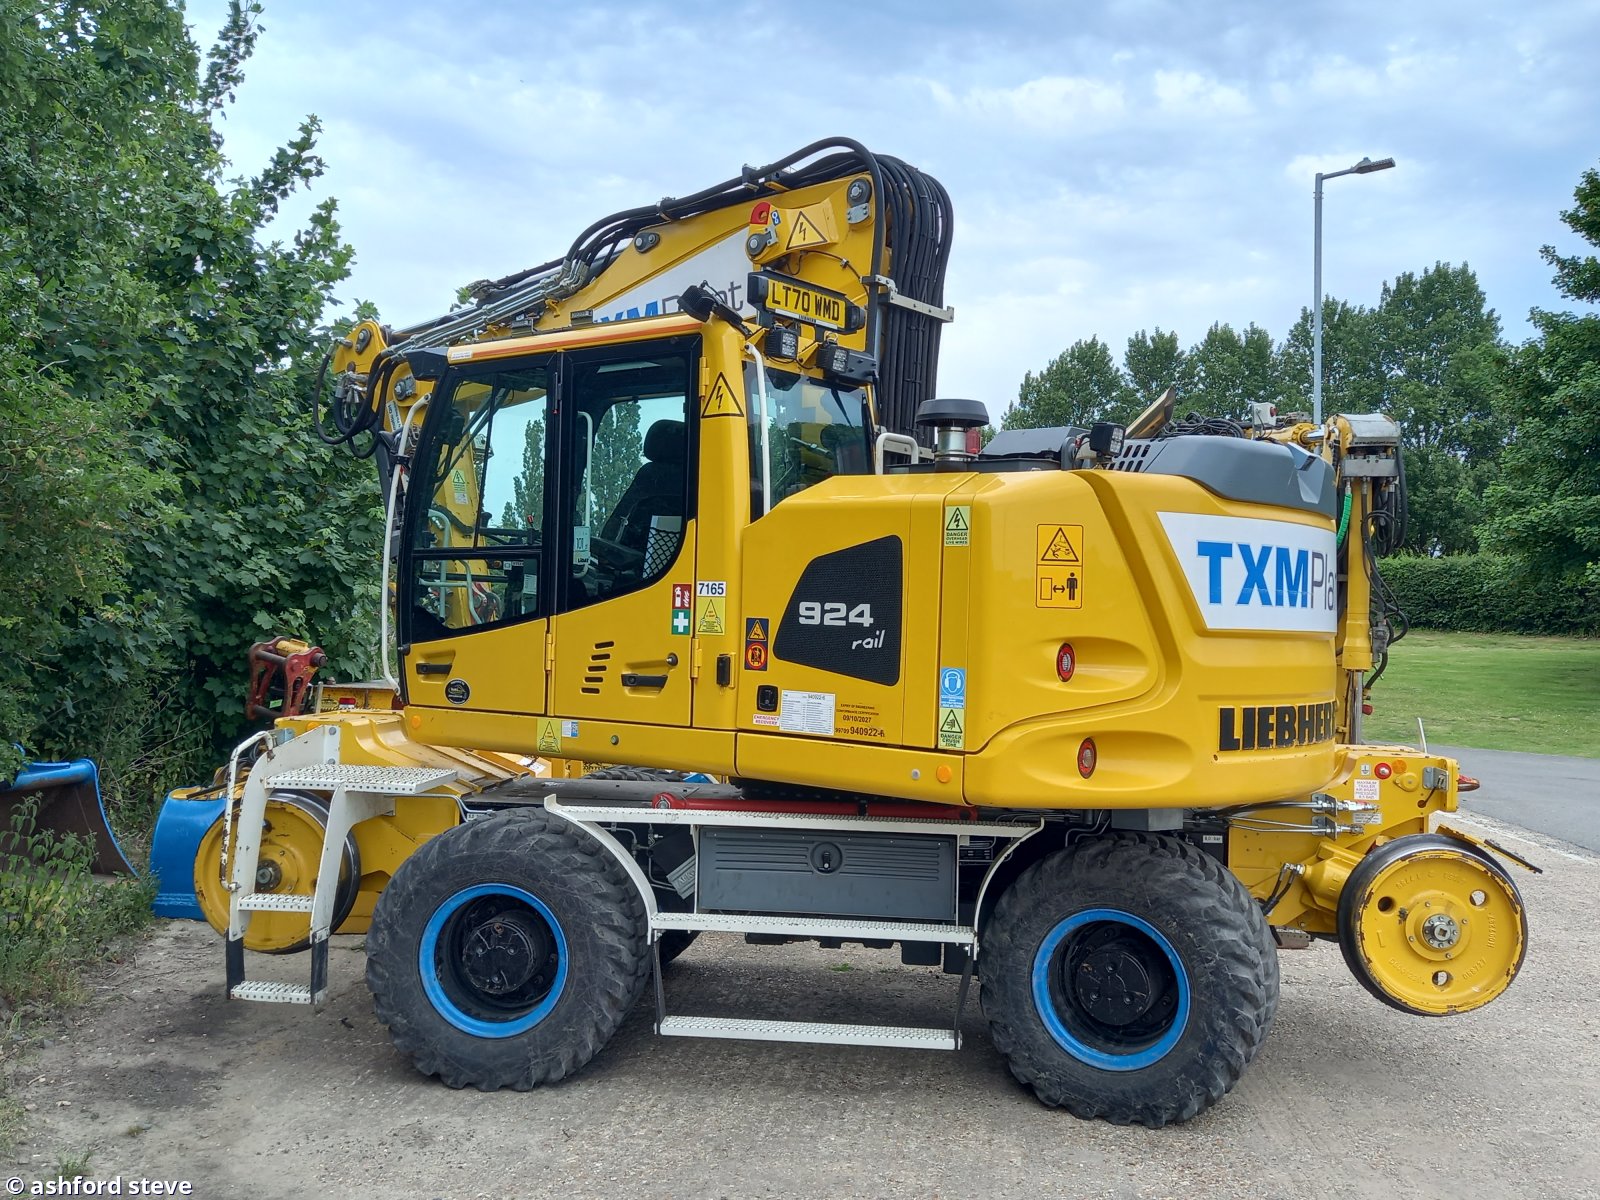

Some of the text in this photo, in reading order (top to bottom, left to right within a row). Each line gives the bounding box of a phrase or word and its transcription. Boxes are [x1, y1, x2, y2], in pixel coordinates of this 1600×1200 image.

[771, 282, 811, 313] LT70
[814, 294, 840, 321] WMD
[1197, 540, 1336, 611] TXMPla
[698, 582, 724, 595] 7165
[798, 602, 874, 627] 924
[851, 630, 885, 649] rail
[842, 714, 872, 723] 09/10/2027
